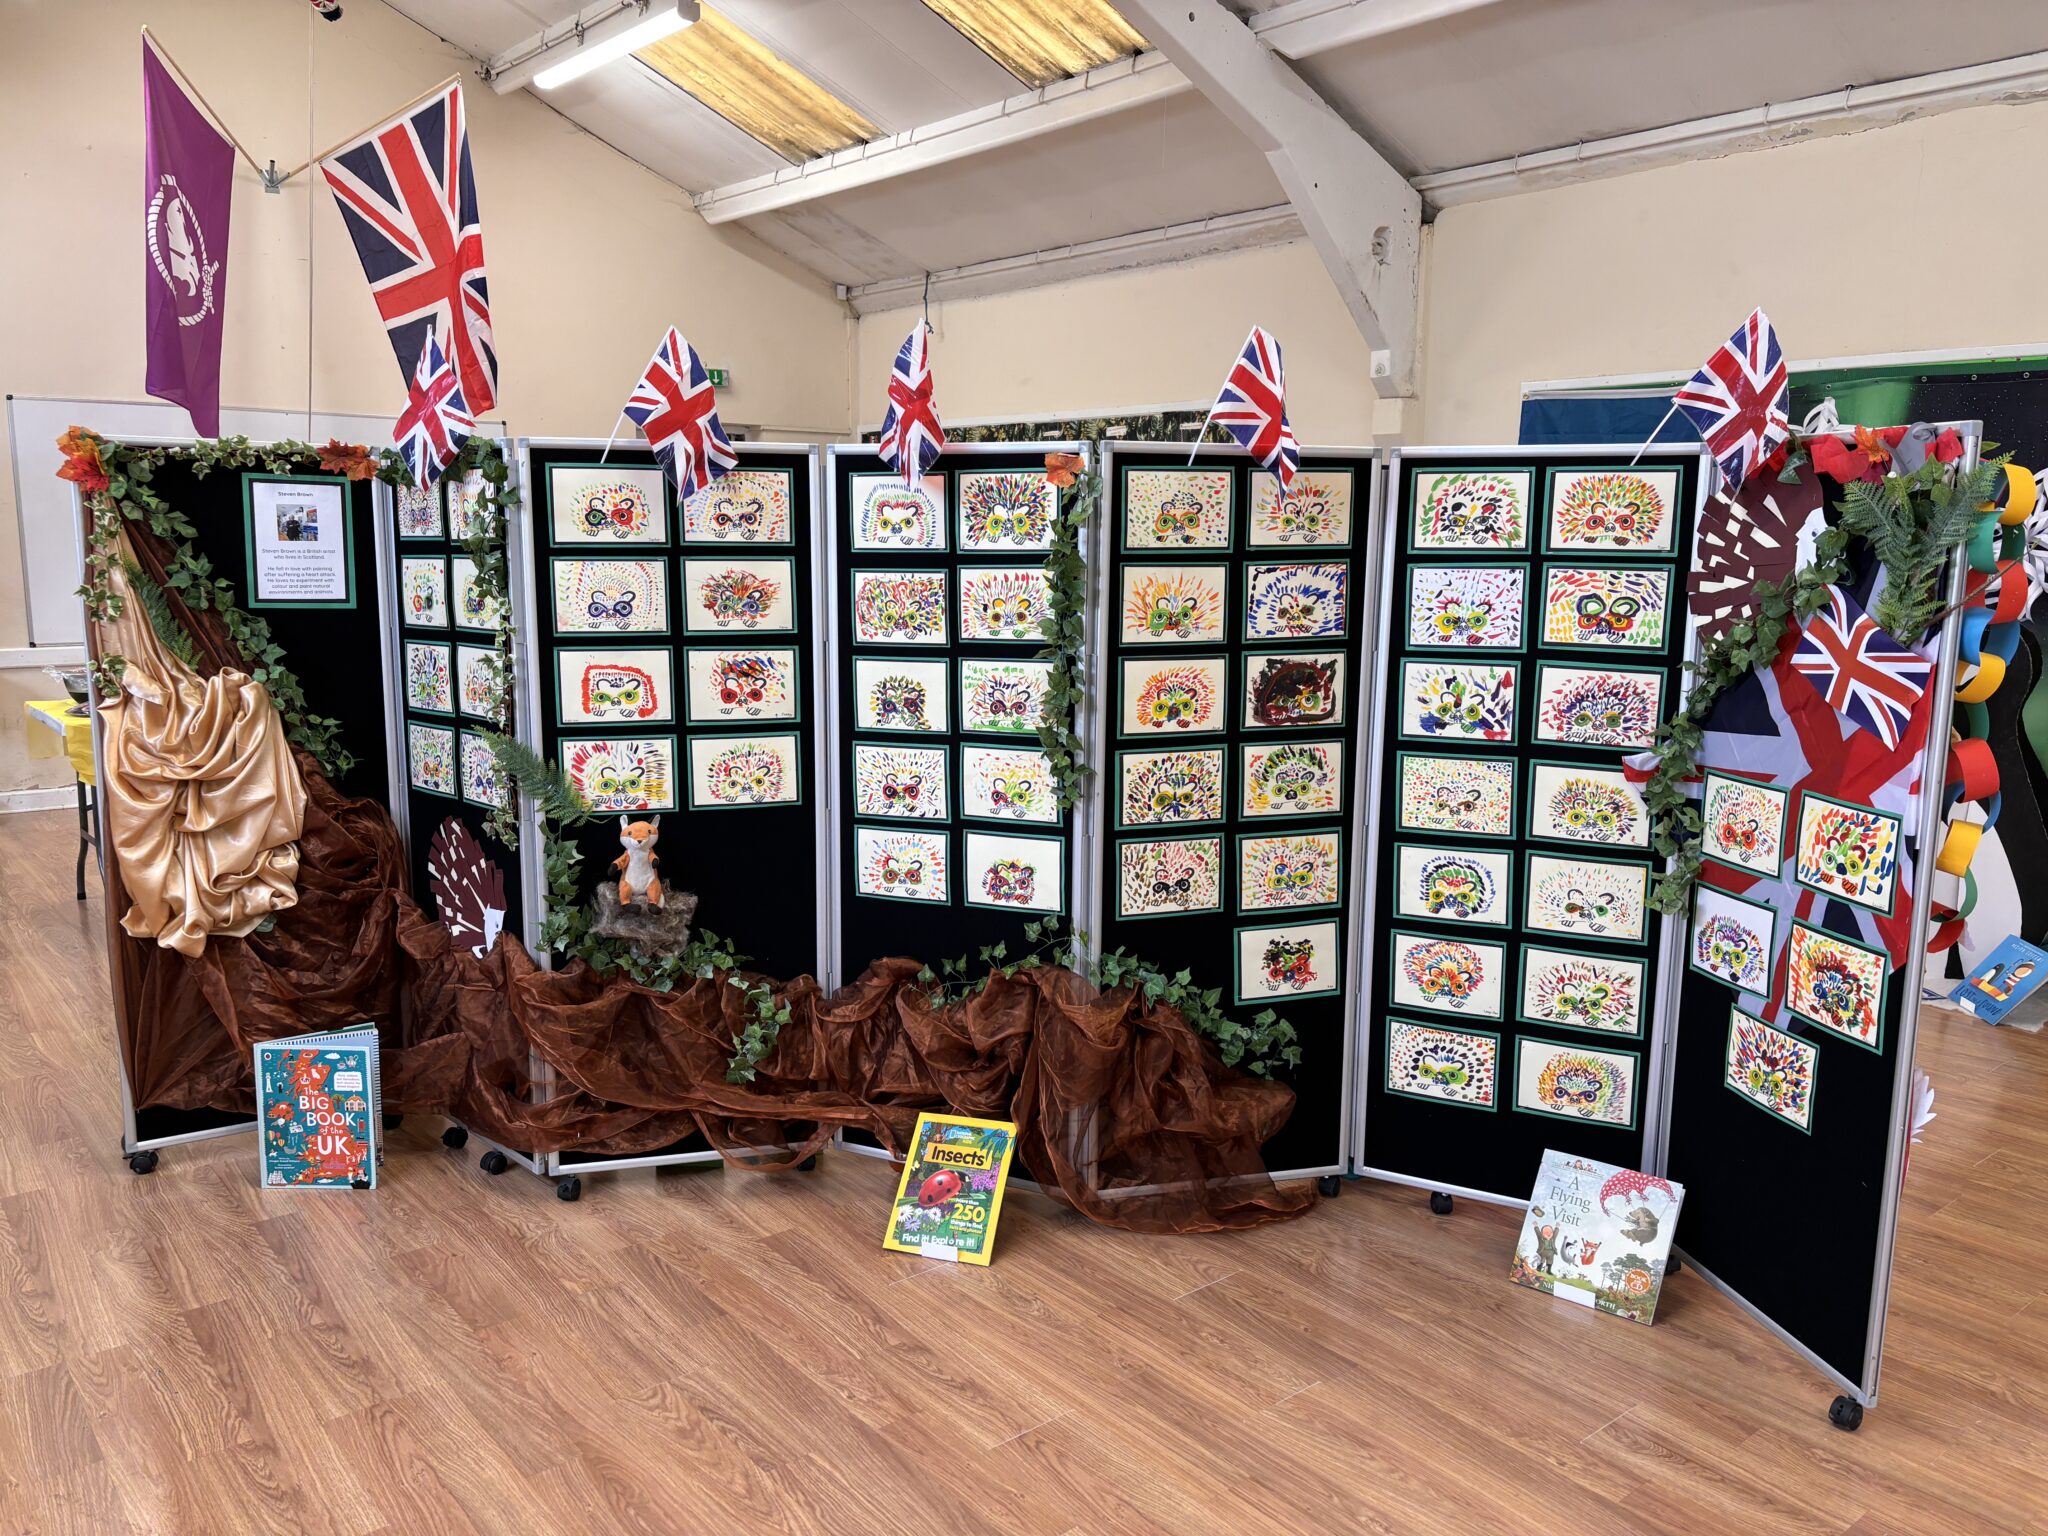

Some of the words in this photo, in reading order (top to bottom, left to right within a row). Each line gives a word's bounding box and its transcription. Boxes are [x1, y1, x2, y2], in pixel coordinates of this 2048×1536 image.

[304, 1087, 319, 1096] The
[299, 1096, 328, 1110] BIG
[306, 1112, 356, 1126] BOOK
[318, 1136, 350, 1155] UK
[932, 1146, 985, 1166] Insects
[1568, 1176, 1581, 1191] A
[1550, 1186, 1592, 1214] Flying
[952, 1203, 986, 1222] 250
[1552, 1206, 1582, 1227] Visit
[902, 1233, 919, 1242] Find
[931, 1236, 964, 1246] Explore
[966, 1237, 975, 1246] it!
[1596, 1300, 1616, 1310] ORTH
